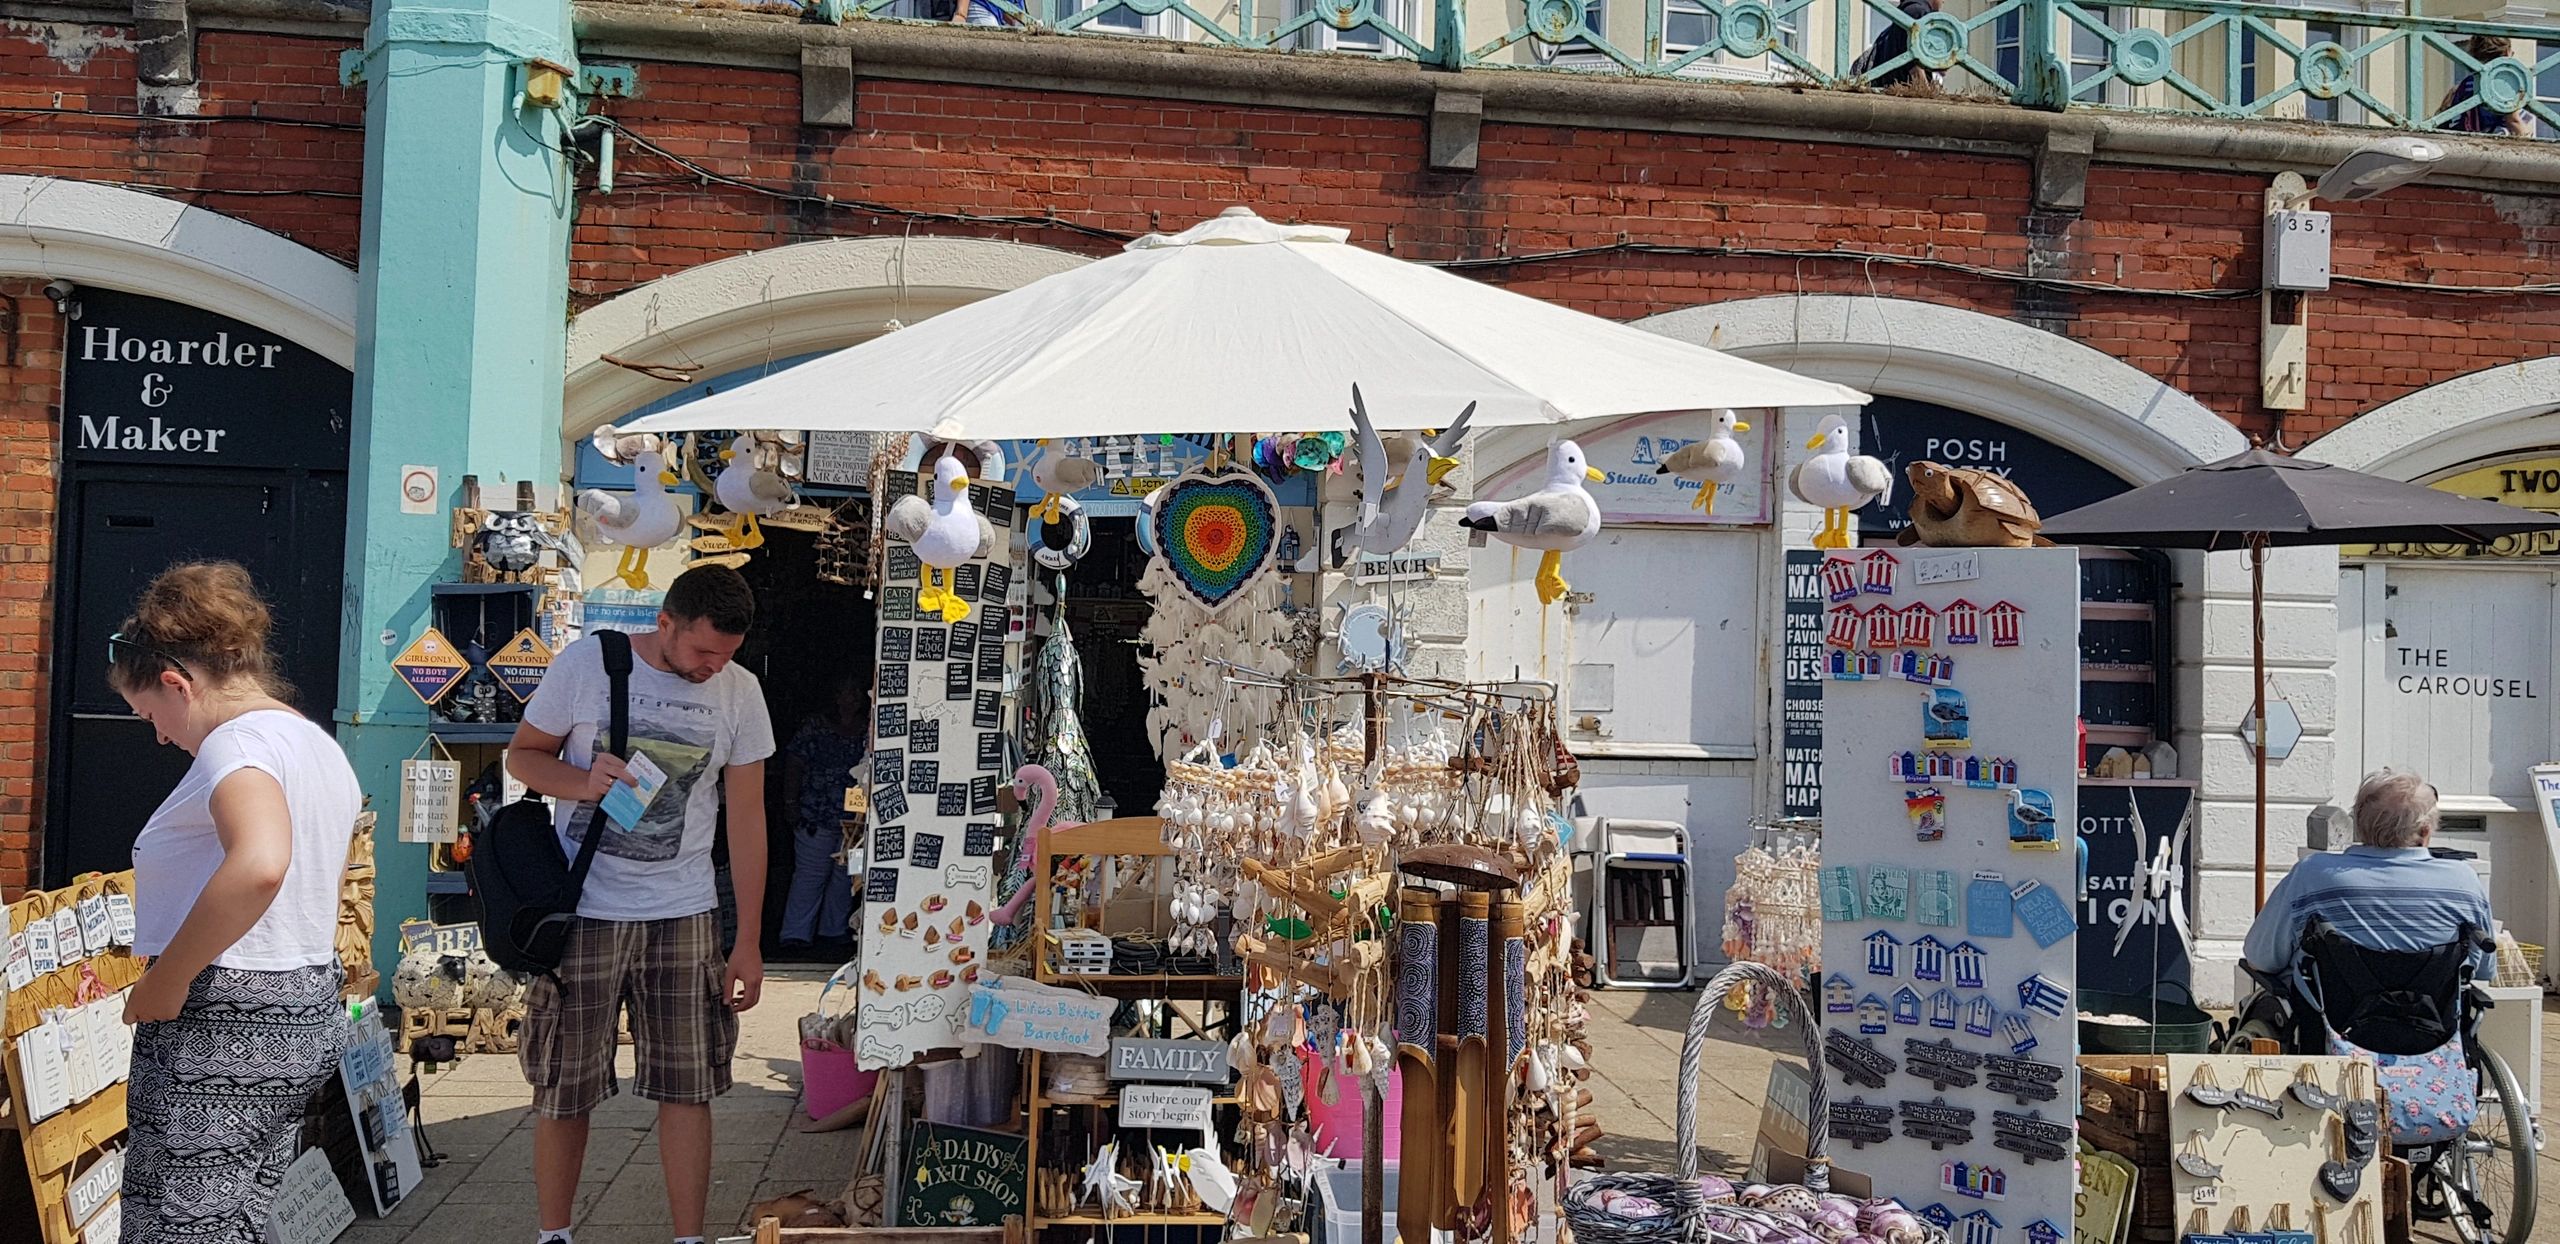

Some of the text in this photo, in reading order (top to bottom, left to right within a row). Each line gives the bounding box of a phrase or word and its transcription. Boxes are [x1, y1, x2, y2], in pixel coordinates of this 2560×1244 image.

[80, 326, 282, 368] Hoarder
[141, 373, 172, 407] &
[77, 415, 226, 453] Maker
[1927, 438, 2006, 462] POSH
[813, 472, 866, 484] MR & MRS
[1604, 471, 1658, 486] Studio
[2501, 470, 2560, 493] TWO
[704, 515, 731, 526] Home
[702, 540, 731, 549] Sweet
[890, 548, 912, 558] DOGS
[1365, 559, 1426, 576] BEACH
[1788, 564, 1809, 575] HOW
[1920, 559, 1973, 581] £2.99
[885, 588, 908, 598] CATS
[1788, 576, 1824, 598] MA
[601, 608, 611, 616] no
[628, 608, 634, 616] is
[1787, 614, 1816, 628] PICK
[884, 628, 908, 638] CATS
[924, 643, 943, 652] DOG
[404, 655, 452, 664] GIRLS ONLY
[499, 655, 549, 664] BOYS ONLY
[2398, 648, 2448, 667] THE
[425, 668, 447, 676] BOYS
[504, 667, 544, 677] NO GIRLS
[888, 679, 907, 687] DOG
[2398, 675, 2537, 698] CAROUSEL
[606, 696, 645, 705] STE
[682, 704, 713, 716] MIND
[1786, 699, 1823, 711] CHOOSE
[888, 726, 905, 734] CAT
[920, 721, 938, 730] DOG
[912, 743, 938, 752] HEART
[407, 766, 455, 782] LOVE
[880, 771, 901, 782] CAT
[1786, 763, 1822, 786] MA
[406, 784, 453, 793] you more
[918, 782, 935, 792] CAT
[2538, 779, 2560, 791] The
[412, 796, 448, 806] than all
[1786, 787, 1819, 806] HAP
[408, 808, 449, 819] the stars
[947, 805, 964, 814] DOG
[404, 823, 451, 837] in the sky
[884, 841, 903, 851] DOG
[916, 835, 937, 846] DOGS
[974, 845, 992, 854] DOG
[870, 871, 893, 880] DOGS
[82, 897, 102, 918] GREAT
[408, 928, 432, 941] Ice cold
[35, 938, 49, 950] JOB
[35, 959, 55, 971] SPINS
[1058, 1002, 1101, 1020] Better
[1024, 1022, 1089, 1044] Barefoot
[1838, 1037, 1855, 1049] THIS
[1916, 1044, 1935, 1054] THIS
[1119, 1046, 1221, 1072] FAMILY
[1854, 1051, 1878, 1069] BEACH
[1919, 1050, 1963, 1066] THE BEACH
[2017, 1069, 2045, 1079] BEACH
[1129, 1091, 1203, 1105] is where our
[1910, 1105, 1928, 1114] THIS
[1129, 1108, 1200, 1124] story begins
[1850, 1113, 1876, 1122] BEACH
[1913, 1112, 1957, 1124] THE BEACH
[2005, 1117, 2023, 1125] THIS
[2008, 1123, 2054, 1140] THE BEACH
[943, 1139, 1004, 1169] DAD'S
[75, 1160, 117, 1215] HOME
[974, 1169, 1019, 1208] SHOP
